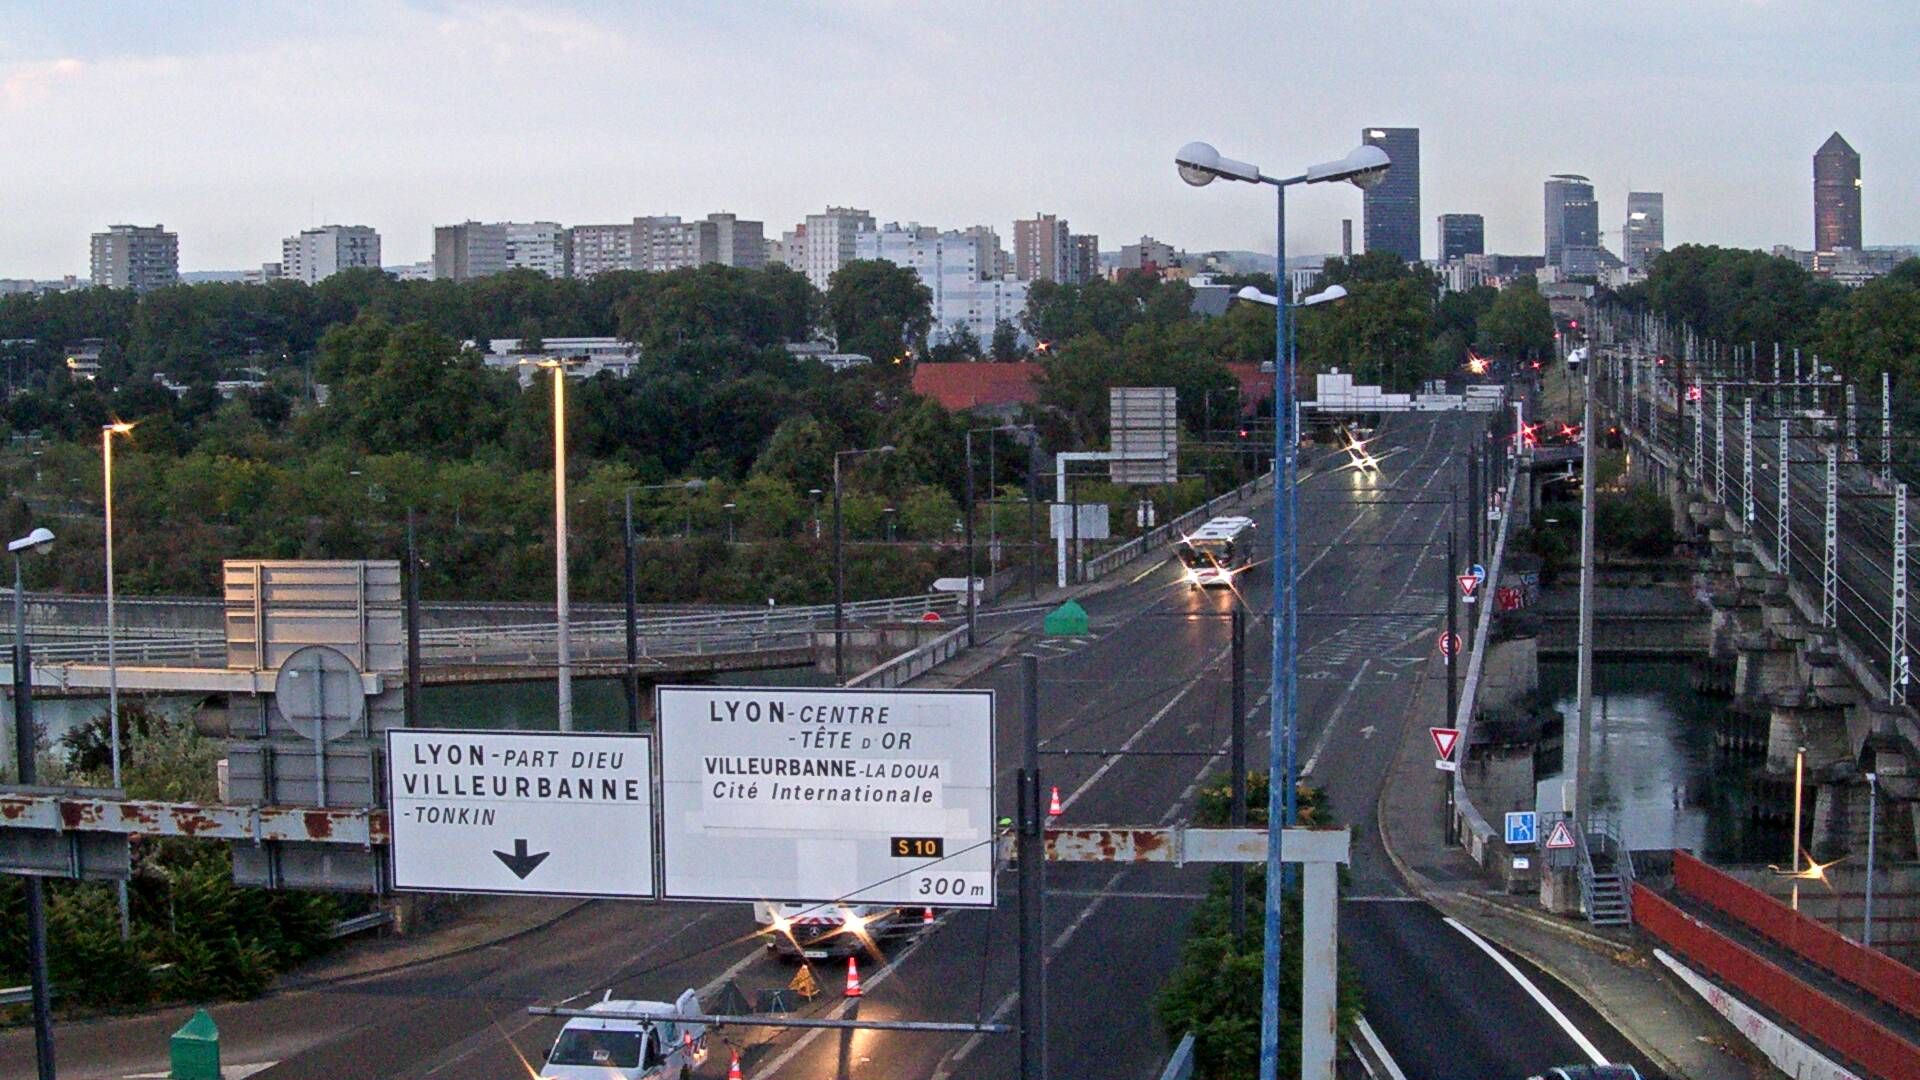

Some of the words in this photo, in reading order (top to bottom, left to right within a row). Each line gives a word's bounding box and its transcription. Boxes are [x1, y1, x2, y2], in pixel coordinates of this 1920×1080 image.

[571, 751, 624, 769] DIEU
[891, 765, 940, 779] DOUA
[403, 774, 639, 800] VILLEURBANNE
[712, 781, 758, 799] Cité
[772, 783, 933, 803] Internationale
